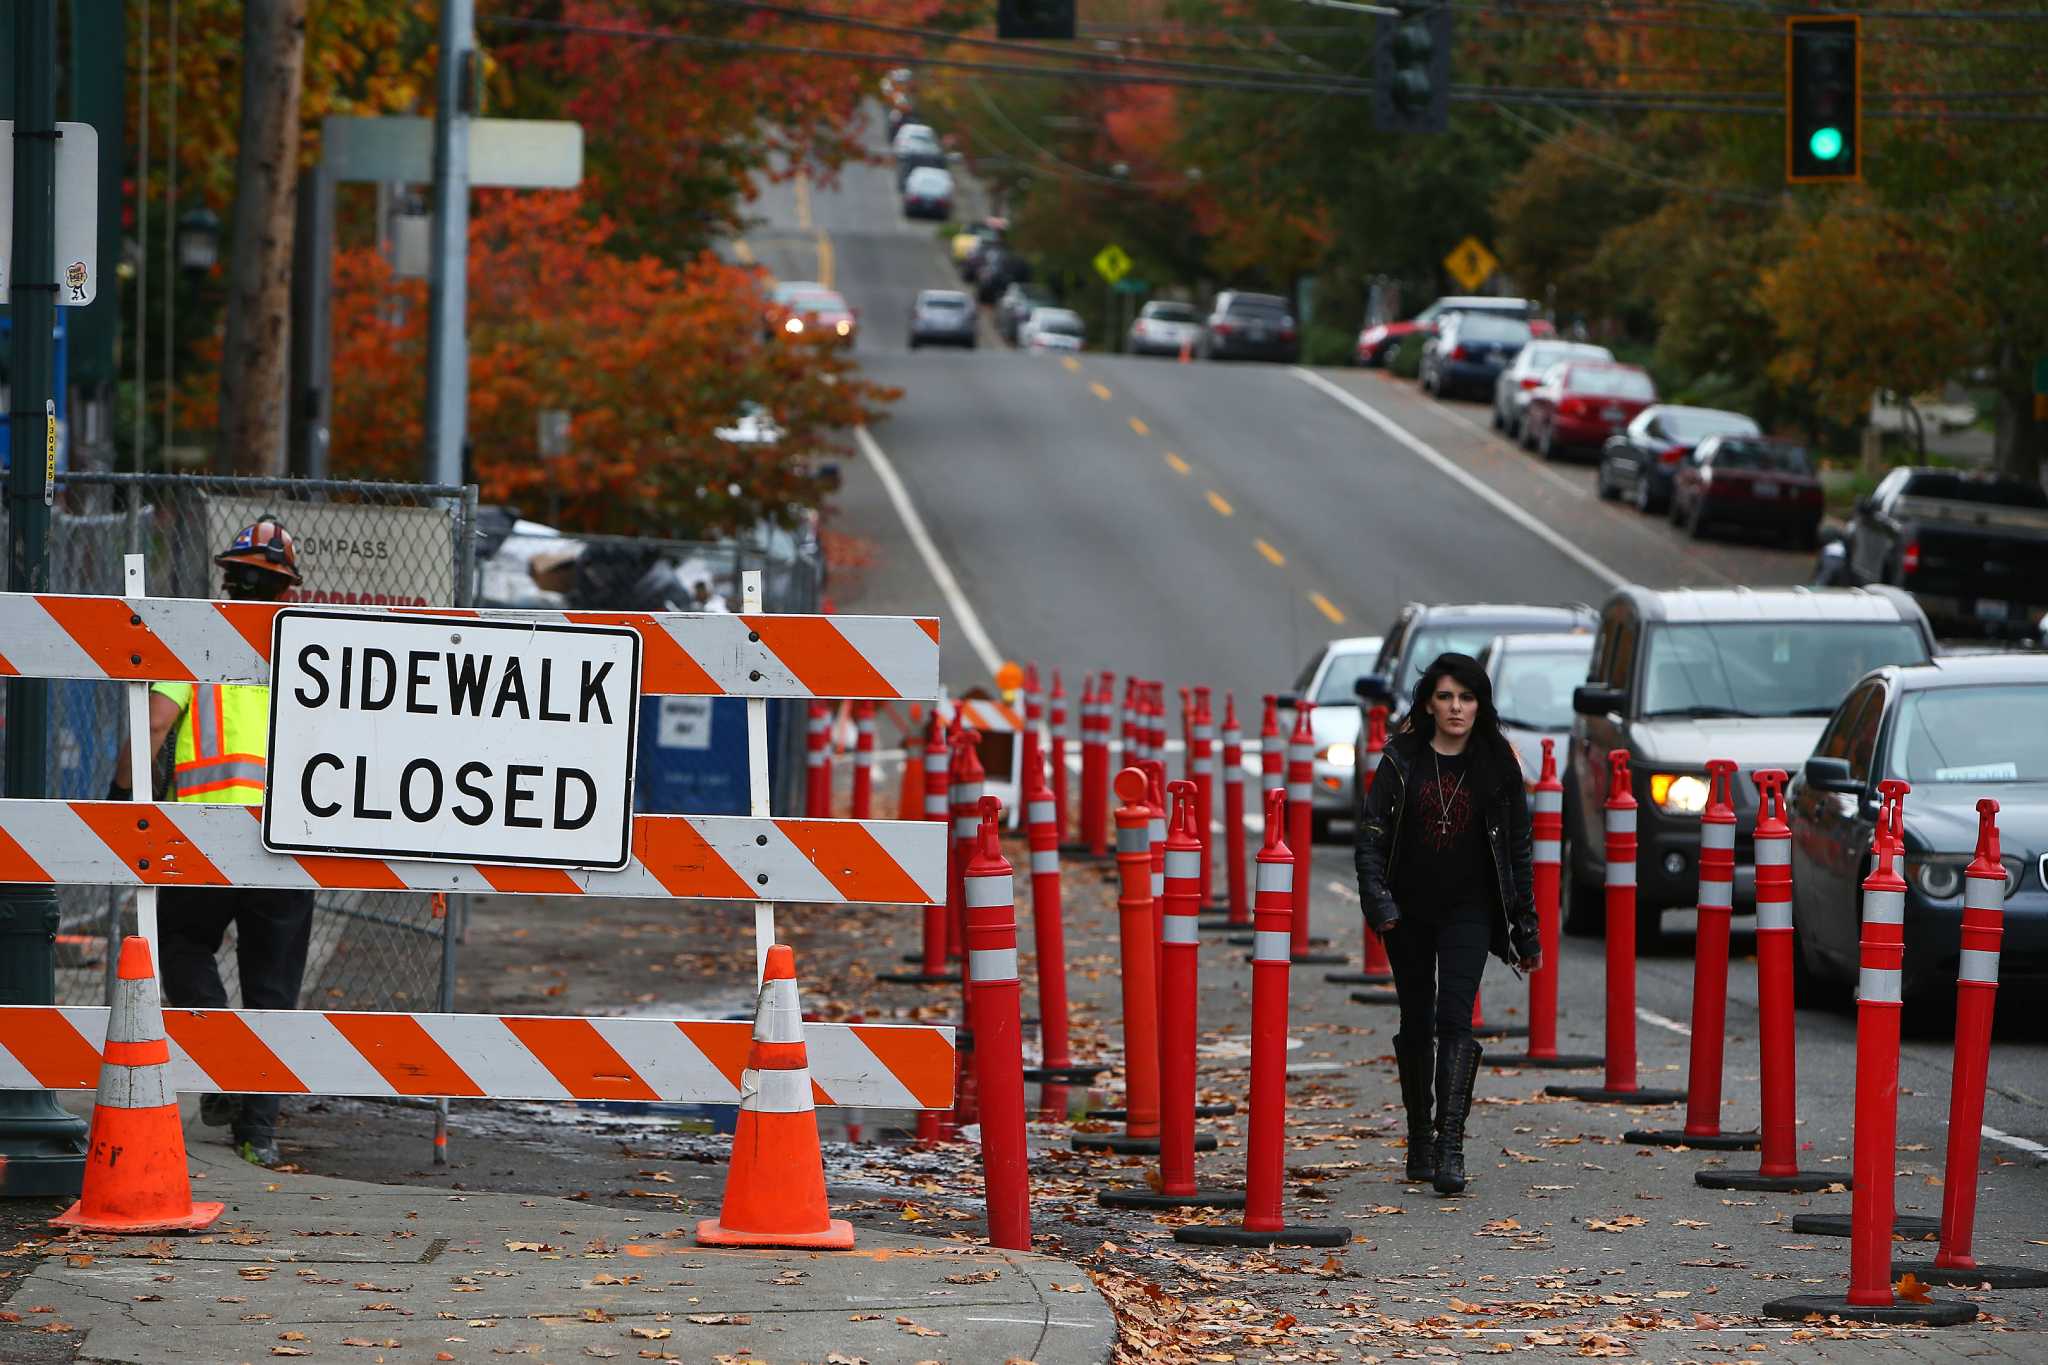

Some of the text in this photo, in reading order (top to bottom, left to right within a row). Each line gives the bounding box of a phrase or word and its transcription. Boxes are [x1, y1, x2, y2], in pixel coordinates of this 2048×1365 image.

[293, 537, 389, 560] COMPASS
[295, 644, 615, 724] SIDEWALK
[301, 753, 597, 830] CLOSED
